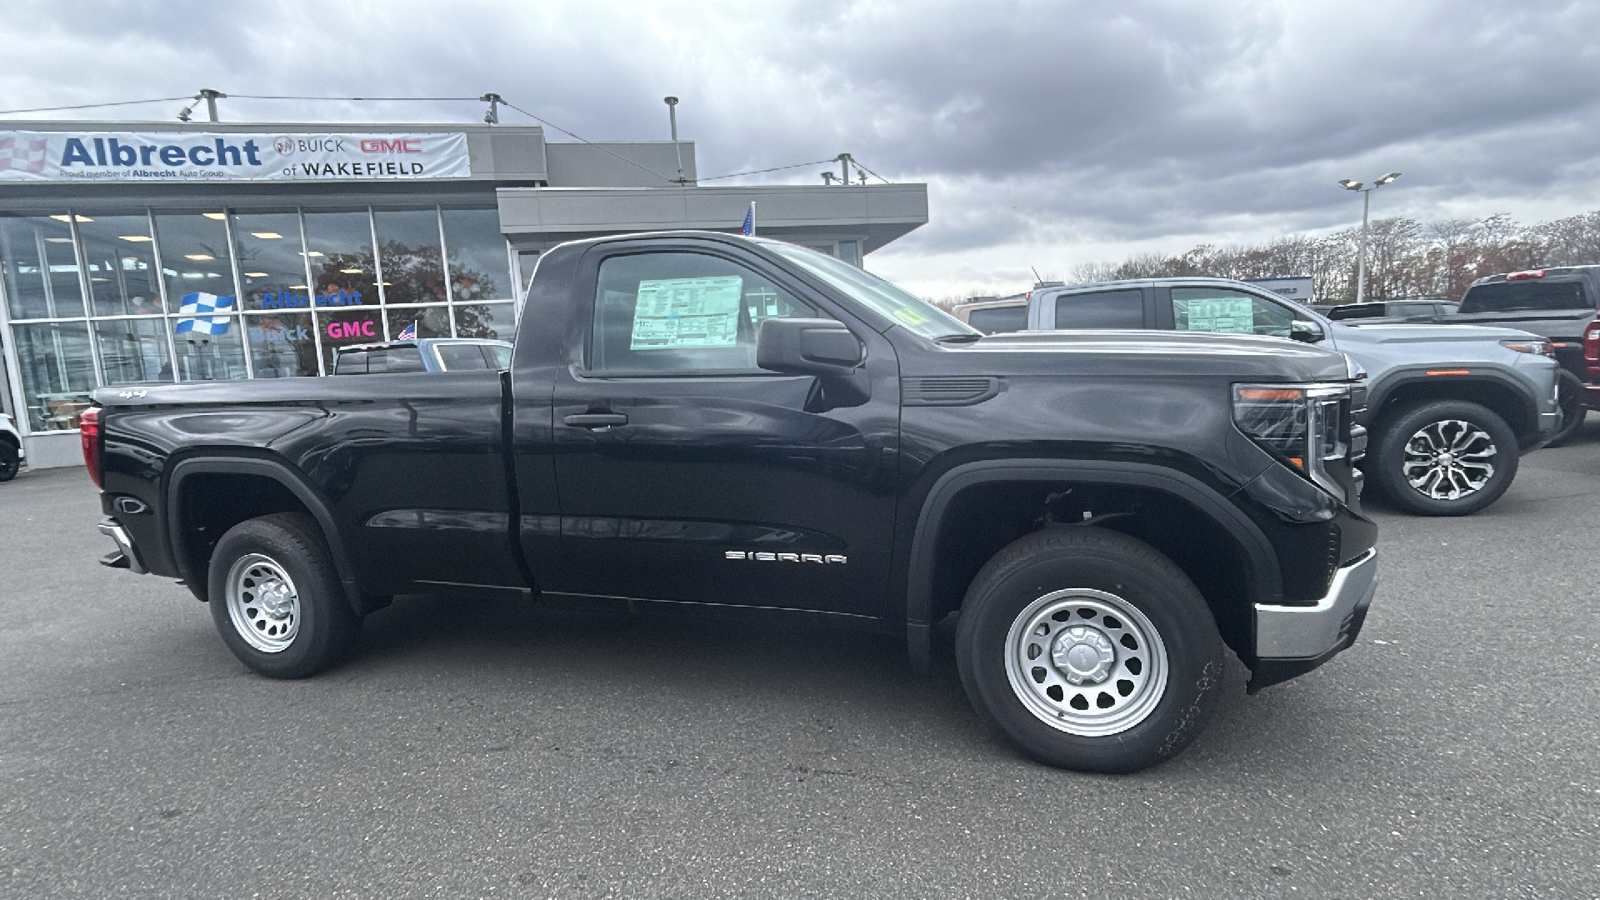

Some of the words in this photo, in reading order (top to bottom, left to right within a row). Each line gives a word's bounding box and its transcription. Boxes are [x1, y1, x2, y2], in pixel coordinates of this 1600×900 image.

[61, 138, 262, 167] Albrecht
[299, 140, 345, 152] BUICK
[360, 139, 422, 153] GMC
[87, 170, 120, 178] member
[200, 170, 224, 178] Group
[283, 167, 297, 176] of
[302, 162, 424, 176] WAKEFIELD
[262, 289, 362, 309] Albrecht
[252, 325, 310, 343] Buick
[327, 321, 376, 339] GMC
[725, 551, 847, 564] SIERRA
